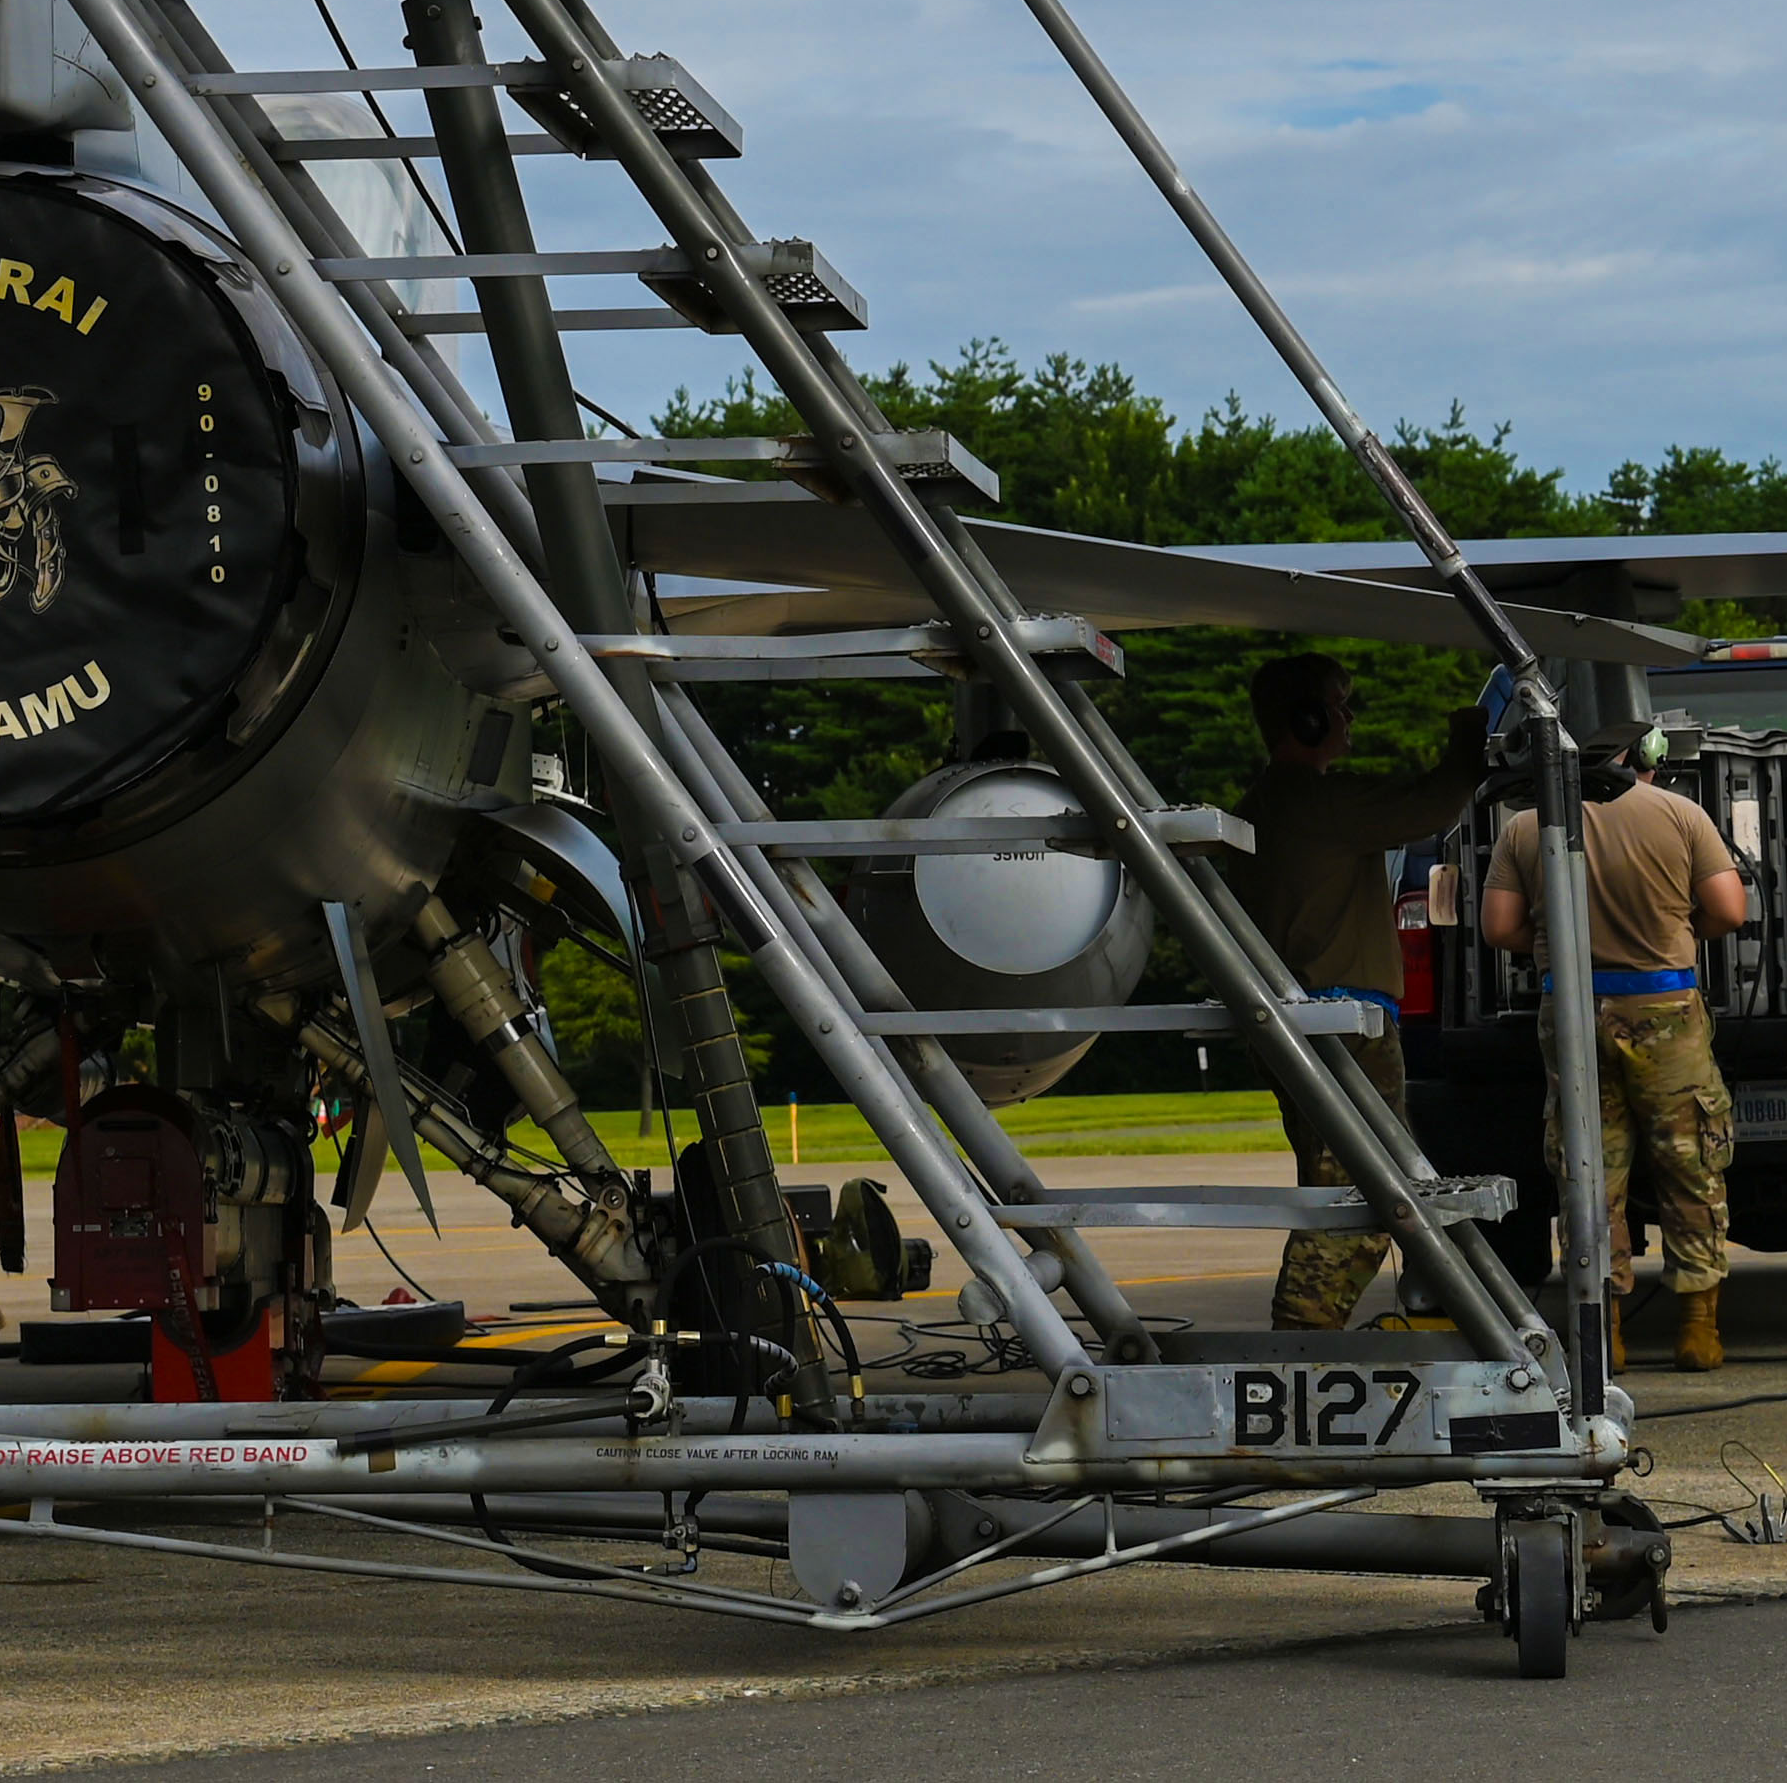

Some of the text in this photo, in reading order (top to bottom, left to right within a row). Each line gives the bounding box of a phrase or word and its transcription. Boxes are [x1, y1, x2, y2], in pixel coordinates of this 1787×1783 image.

[197, 383, 226, 584] 90-0810
[1234, 1370, 1422, 1446] B127
[27, 1448, 96, 1465] RAISE
[100, 1447, 182, 1464] ABOVE
[188, 1447, 235, 1463] RED
[242, 1446, 308, 1463] BAND
[595, 1447, 839, 1462] CAUTION CLOSE VALVE AFTER LOCKING RAM
